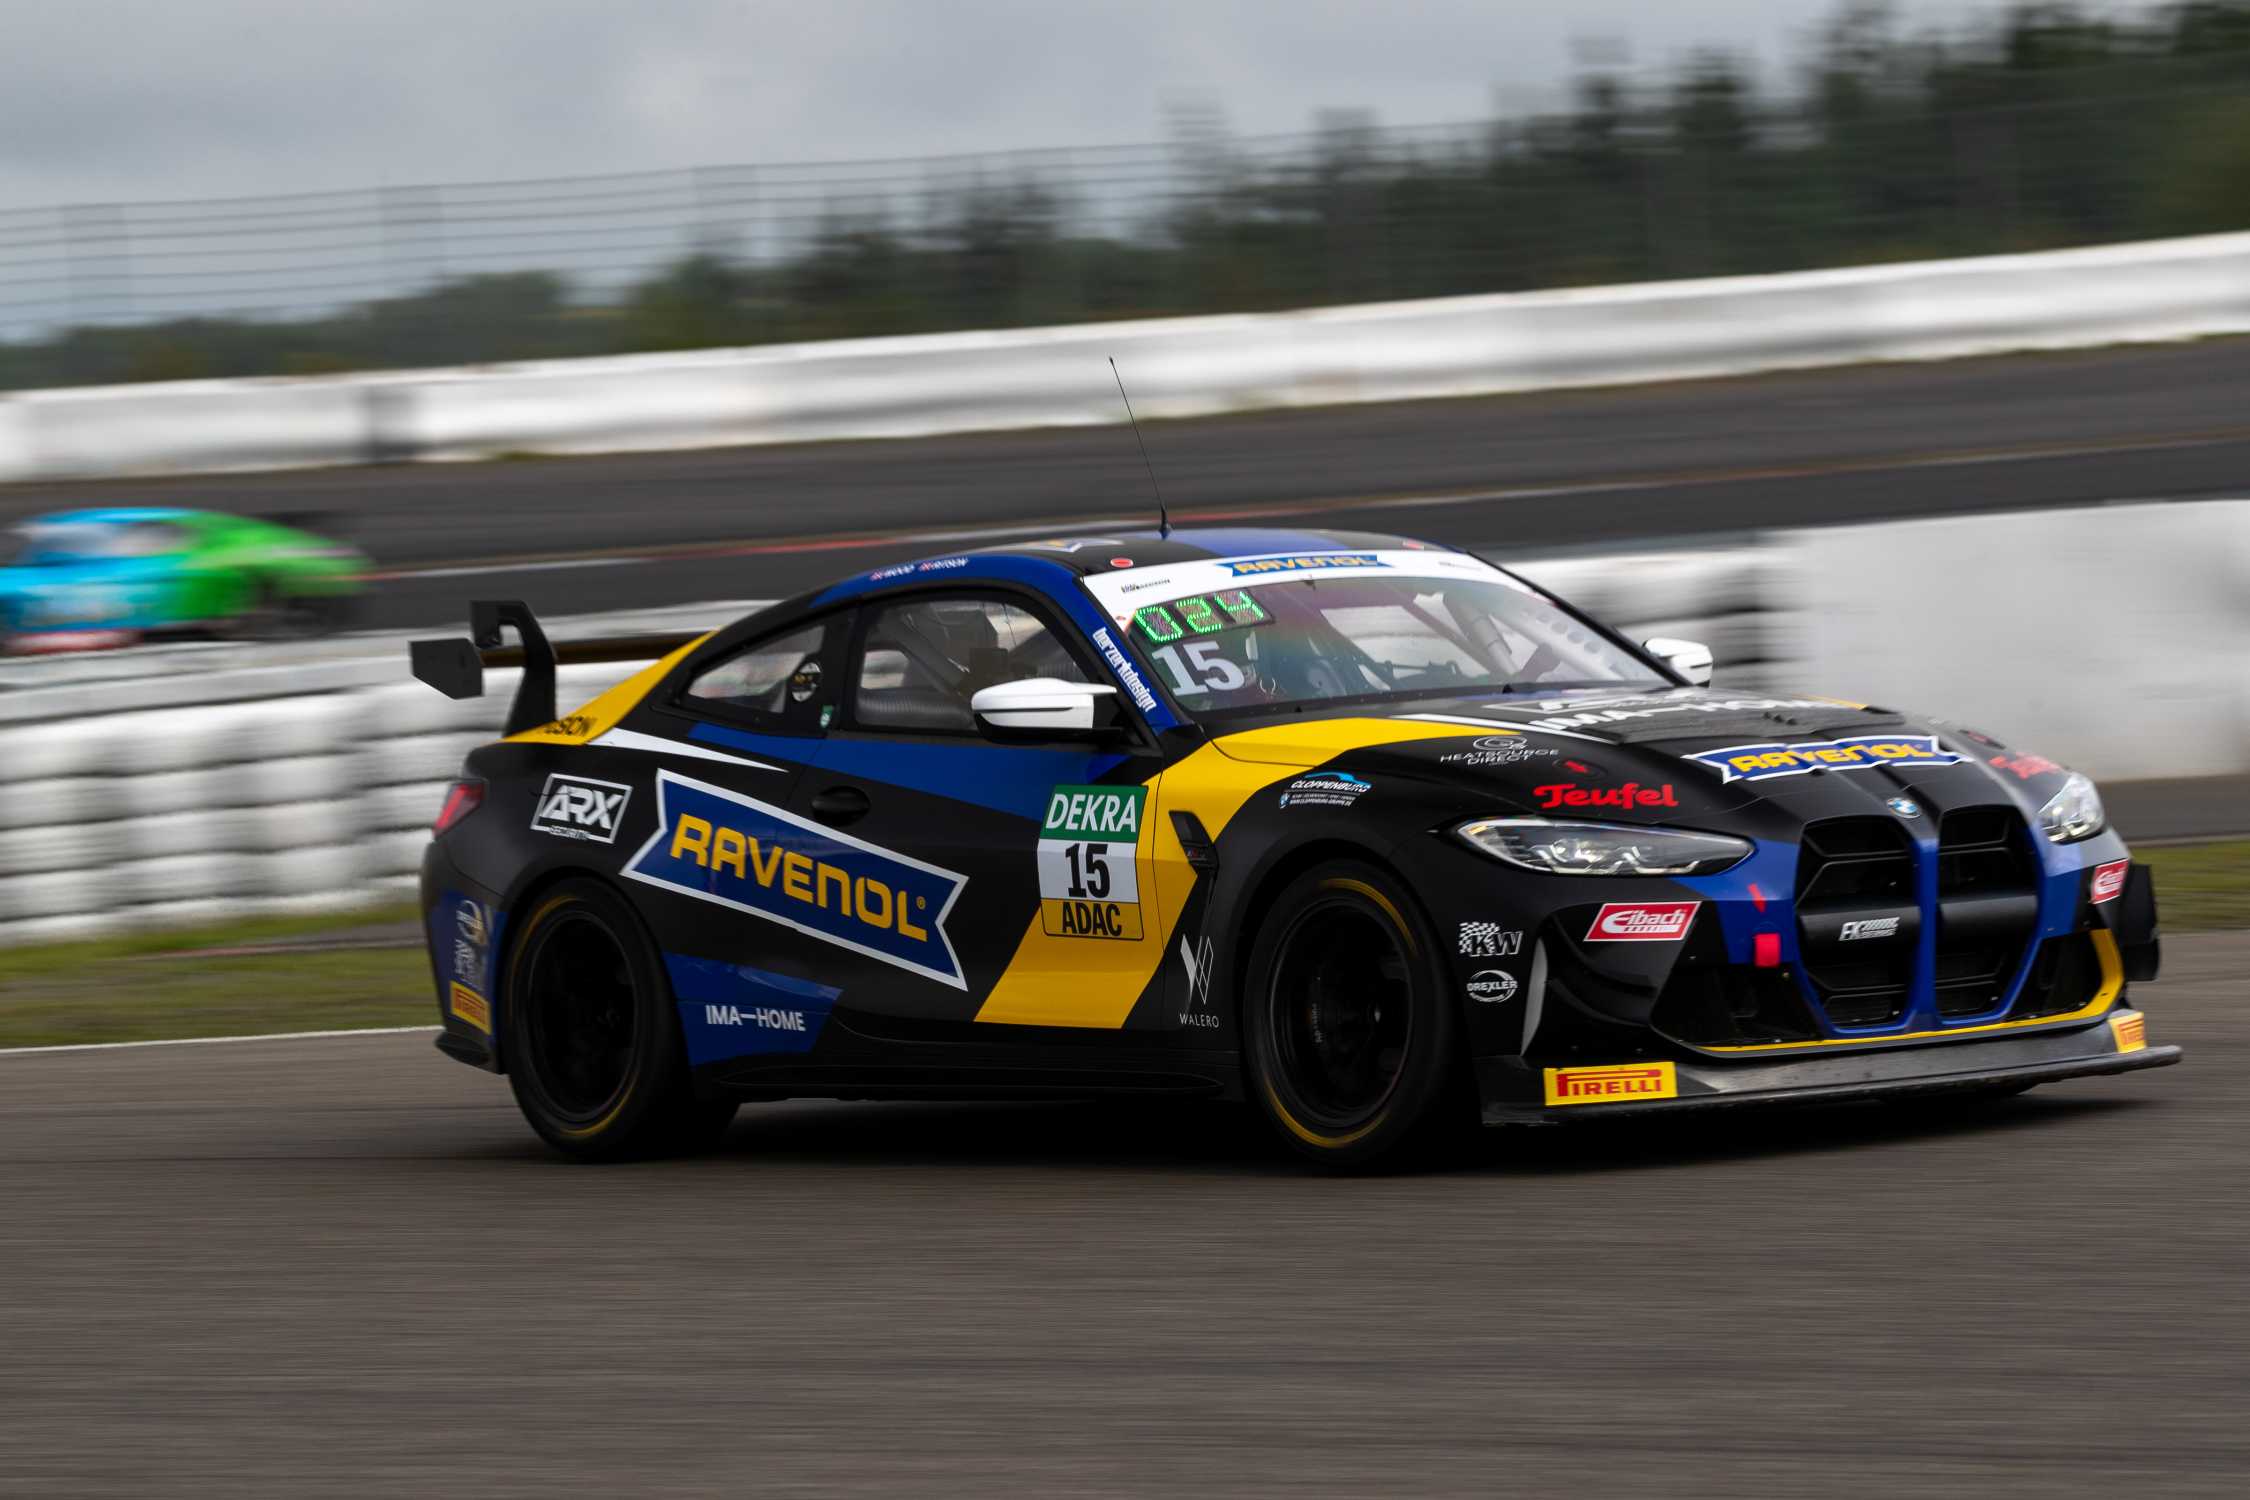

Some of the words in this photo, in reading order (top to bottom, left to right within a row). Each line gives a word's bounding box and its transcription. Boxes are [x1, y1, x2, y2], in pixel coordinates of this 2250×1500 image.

[1152, 641, 1246, 696] 15
[1440, 748, 1560, 763] HEATSOURCE
[1467, 754, 1530, 766] DIRECT
[1726, 744, 1936, 773] RAVENOL
[540, 784, 624, 830] ARX
[1534, 783, 1679, 809] Teufel
[1046, 794, 1136, 833] DEKRA
[1065, 842, 1111, 898] 15
[1062, 902, 1122, 936] ADAC
[1602, 909, 1686, 934] Eibach
[1468, 931, 1523, 957] KW
[1466, 980, 1519, 993] DREXLER
[1179, 1013, 1220, 1029] WALERO
[1556, 1069, 1663, 1097] PIRELLI
